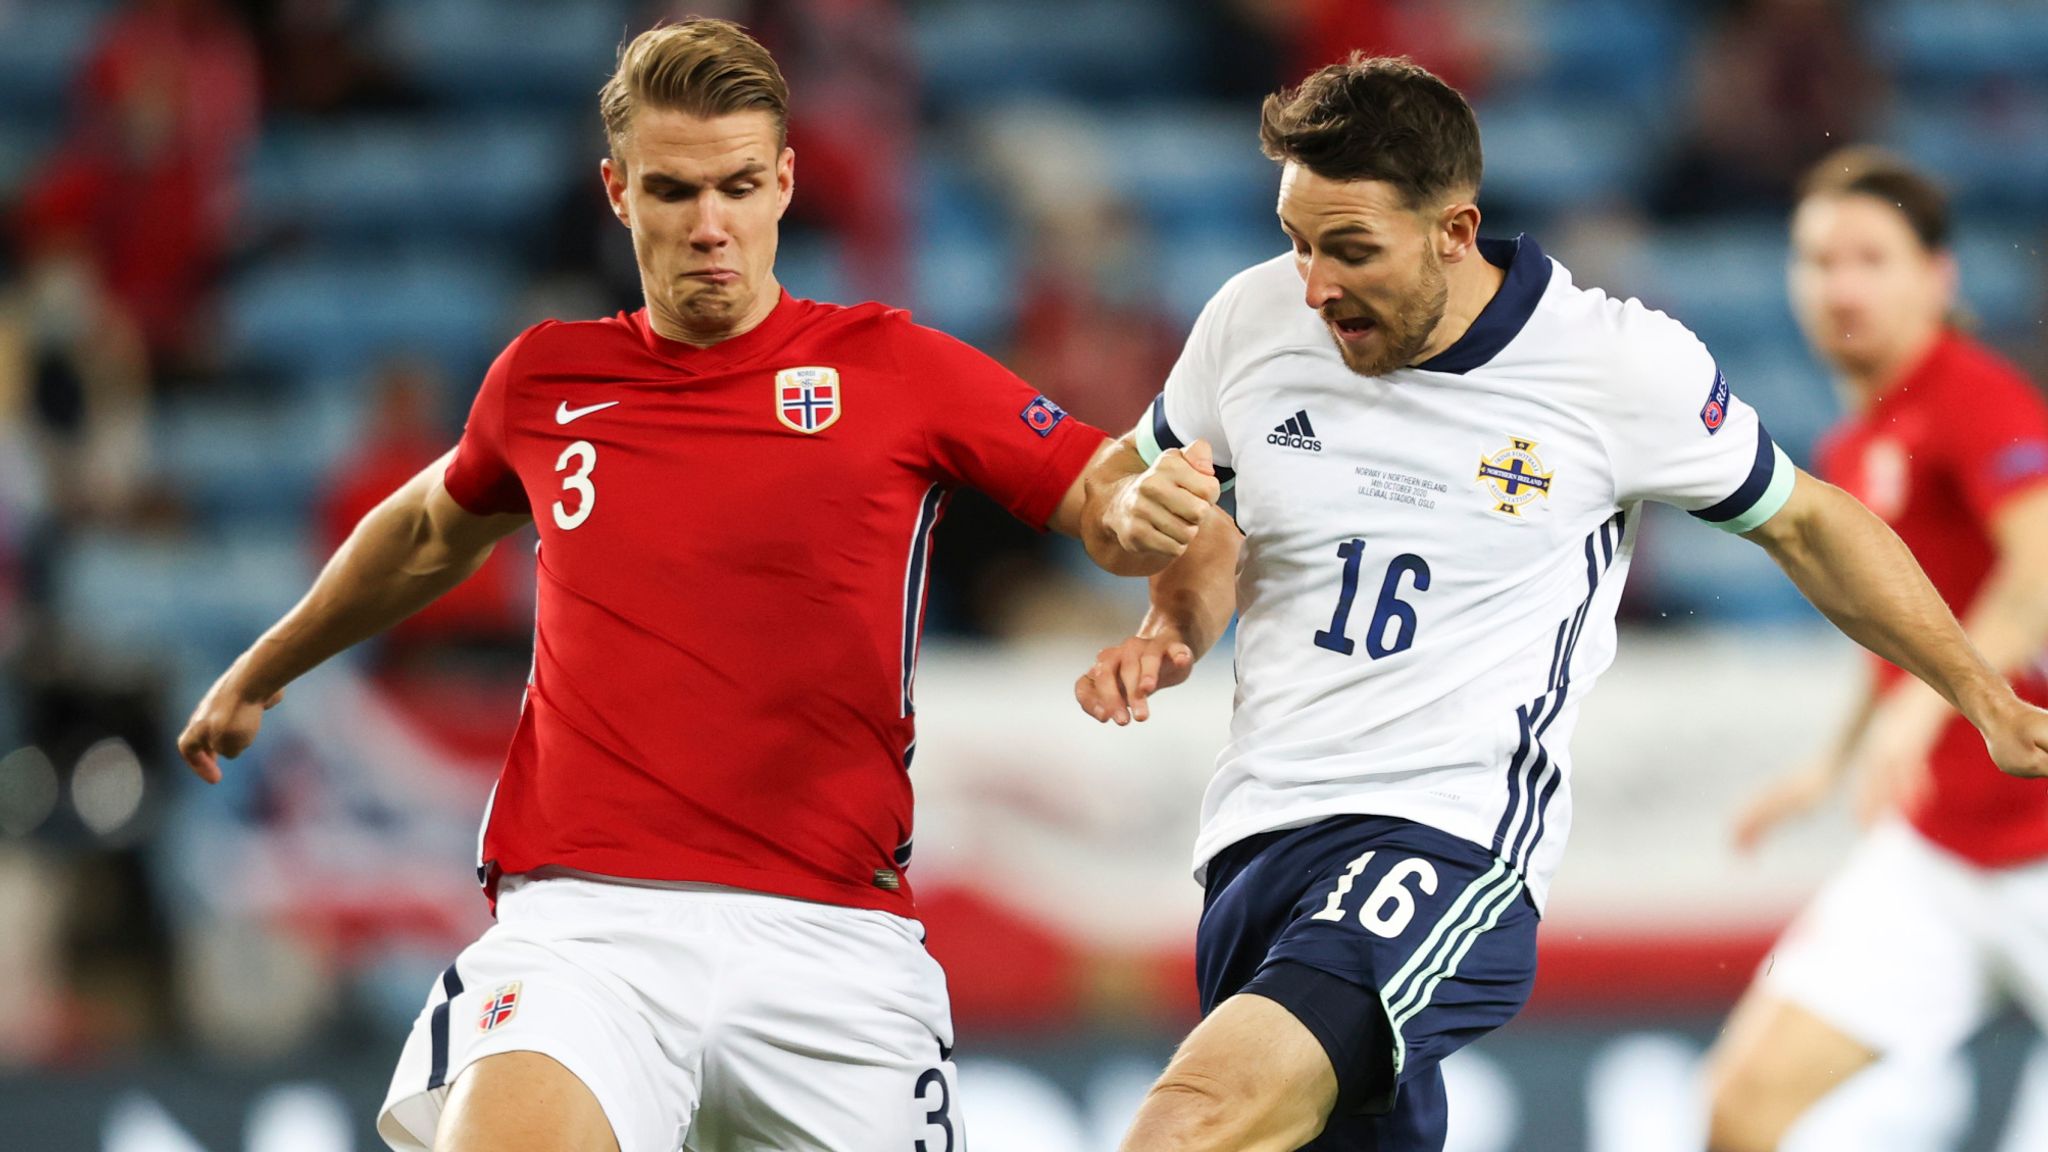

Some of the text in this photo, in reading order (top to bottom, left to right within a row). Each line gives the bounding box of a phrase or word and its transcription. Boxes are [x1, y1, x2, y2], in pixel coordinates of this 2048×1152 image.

[1267, 432, 1322, 452] adidas
[552, 440, 597, 530] 3
[1355, 466, 1381, 478] NORWAY
[1387, 472, 1421, 487] NORTHERN
[1421, 479, 1448, 493] IRELAND
[1383, 480, 1412, 494] OCTOBER
[1517, 474, 1543, 487] IRELAND
[1313, 538, 1431, 660] 16
[1310, 850, 1439, 939] 16
[914, 1067, 955, 1152] 3
